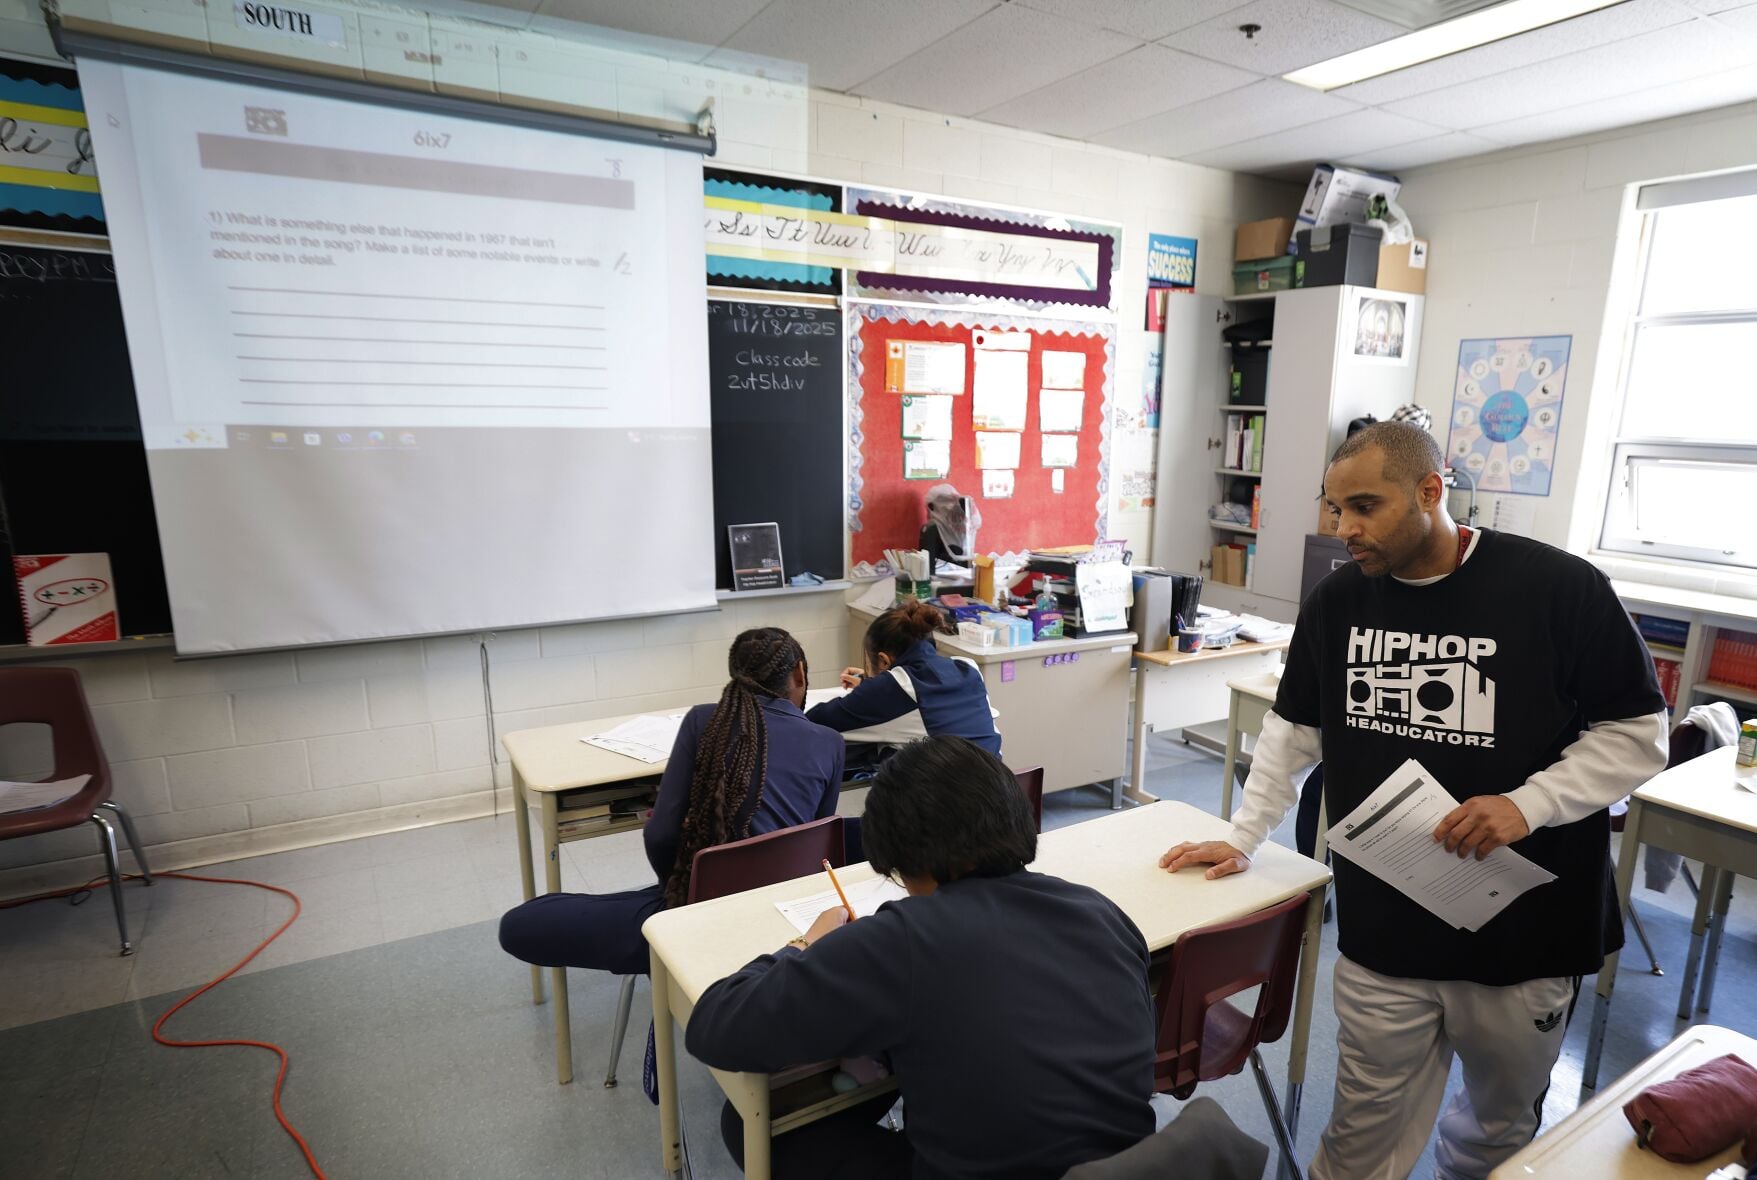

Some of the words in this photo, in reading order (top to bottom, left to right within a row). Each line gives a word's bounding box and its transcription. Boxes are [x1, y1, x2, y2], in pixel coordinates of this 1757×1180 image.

[244, 1, 314, 36] SOUTH
[413, 130, 452, 150] 6ix7
[225, 212, 262, 226] What
[264, 214, 277, 227] is
[280, 217, 346, 235] something
[350, 223, 376, 236] else
[378, 225, 401, 237] that
[404, 226, 463, 243] happened
[465, 230, 477, 242] in
[480, 231, 506, 245] 1967
[509, 234, 531, 247] that
[210, 230, 281, 246] mentioned
[284, 233, 297, 246] in
[300, 235, 320, 248] the
[323, 239, 361, 254] song?
[365, 242, 398, 254] Make
[412, 243, 429, 256] list
[432, 245, 444, 257] of
[446, 248, 477, 259] some
[480, 250, 521, 263] notable
[523, 254, 559, 266] events
[561, 256, 573, 266] or
[575, 256, 600, 268] write
[213, 248, 252, 260] about
[255, 252, 280, 263] one
[283, 252, 296, 263] in
[299, 253, 336, 266] detail.
[1148, 249, 1193, 285] SUCCESS
[733, 319, 836, 336] 11/18/2025
[760, 305, 818, 320] 2025
[1346, 715, 1495, 748] HEADUCATORZ
